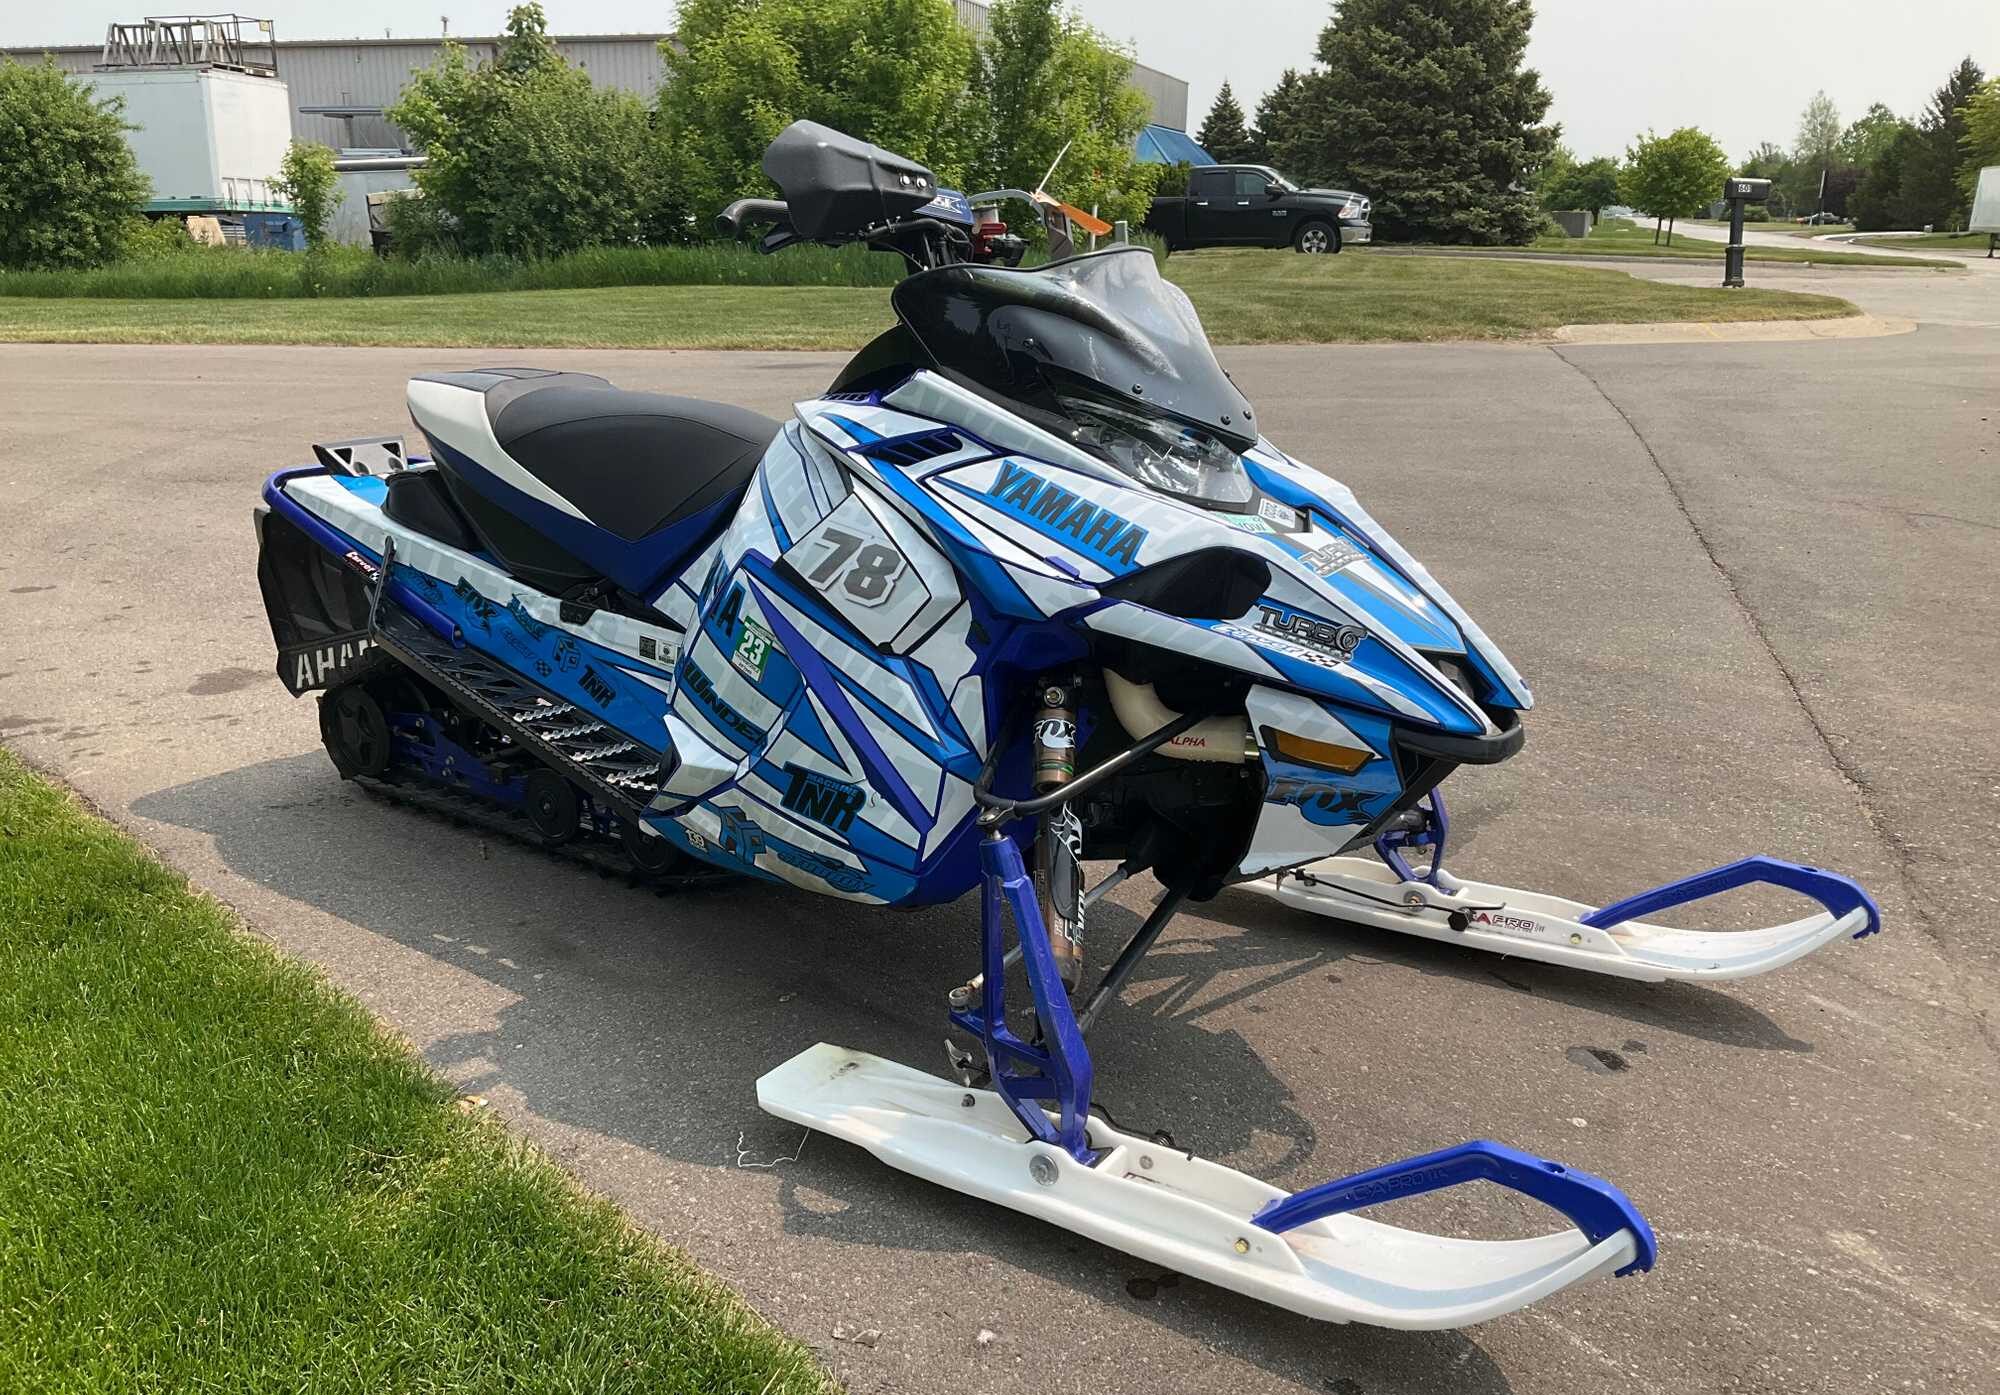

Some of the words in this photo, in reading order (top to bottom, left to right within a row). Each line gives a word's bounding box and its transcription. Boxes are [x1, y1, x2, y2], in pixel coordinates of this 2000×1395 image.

[991, 463, 1146, 566] YAMAHA
[807, 526, 902, 601] 78
[739, 630, 765, 666] 23
[577, 663, 617, 709] TNR
[781, 761, 867, 832] TNR
[1265, 776, 1384, 824] FOX
[1493, 914, 1535, 932] PRO
